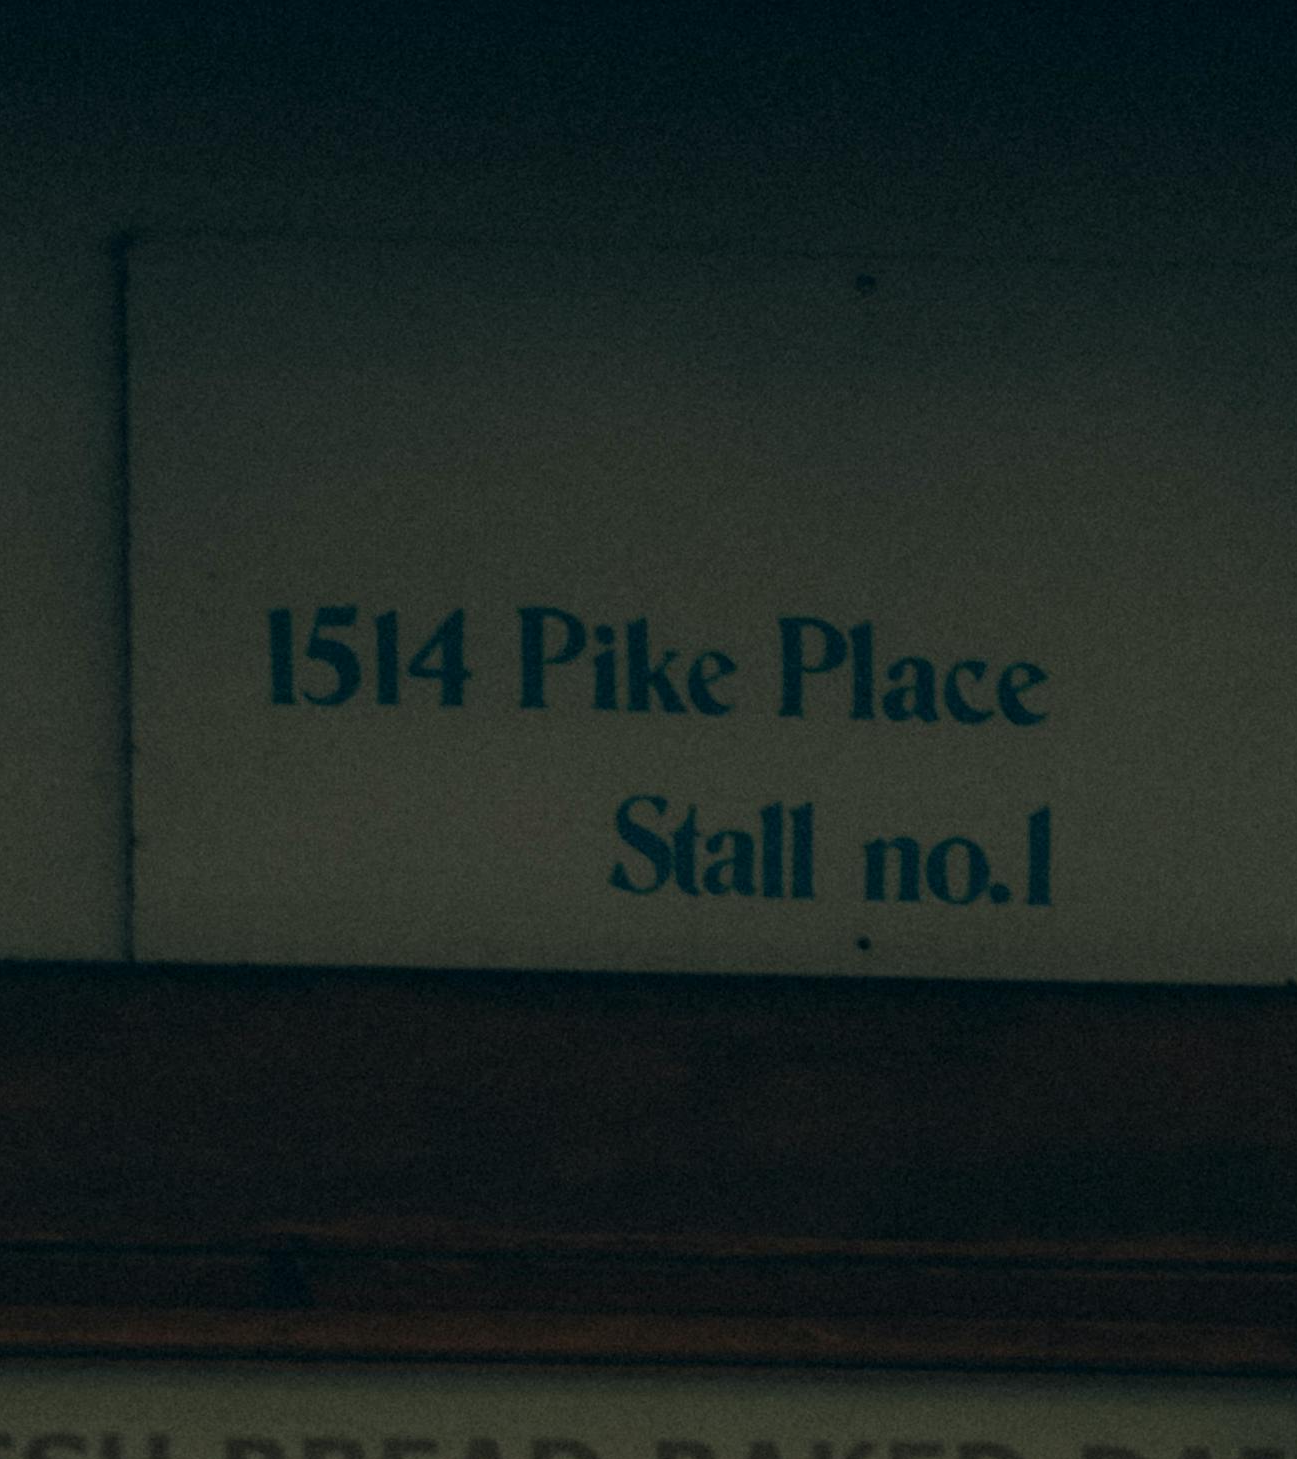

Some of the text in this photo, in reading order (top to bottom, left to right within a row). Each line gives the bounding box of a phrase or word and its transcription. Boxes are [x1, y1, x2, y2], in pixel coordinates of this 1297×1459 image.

[268, 606, 1047, 726] 1514 Pike Place
[610, 795, 1053, 906] Stall no.1
